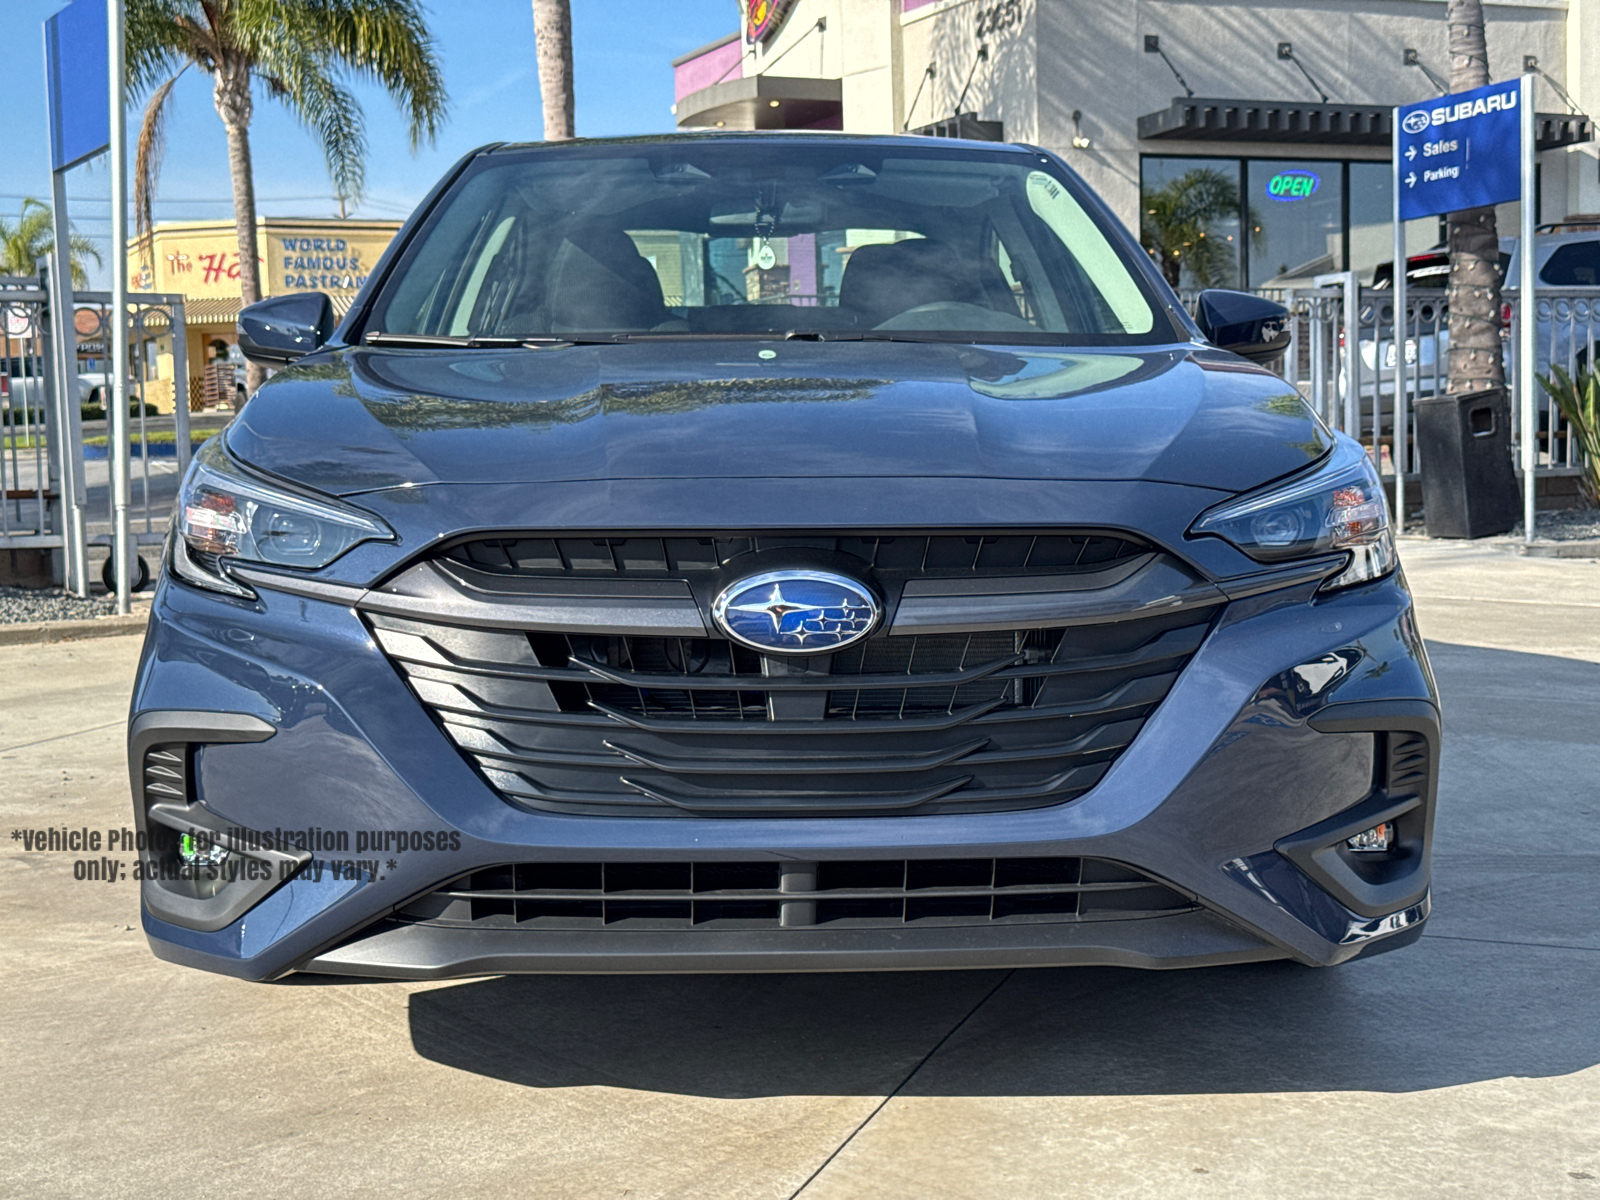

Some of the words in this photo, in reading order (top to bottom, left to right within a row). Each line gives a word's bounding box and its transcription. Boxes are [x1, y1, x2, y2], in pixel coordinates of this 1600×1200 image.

[1431, 90, 1517, 126] SUBARU
[1422, 140, 1458, 157] Sales
[1423, 166, 1460, 182] Parking
[1269, 174, 1314, 197] OPEN
[282, 238, 347, 252] WORLD
[167, 250, 193, 275] The
[198, 252, 264, 284] Ha
[284, 256, 359, 270] FAMOUS
